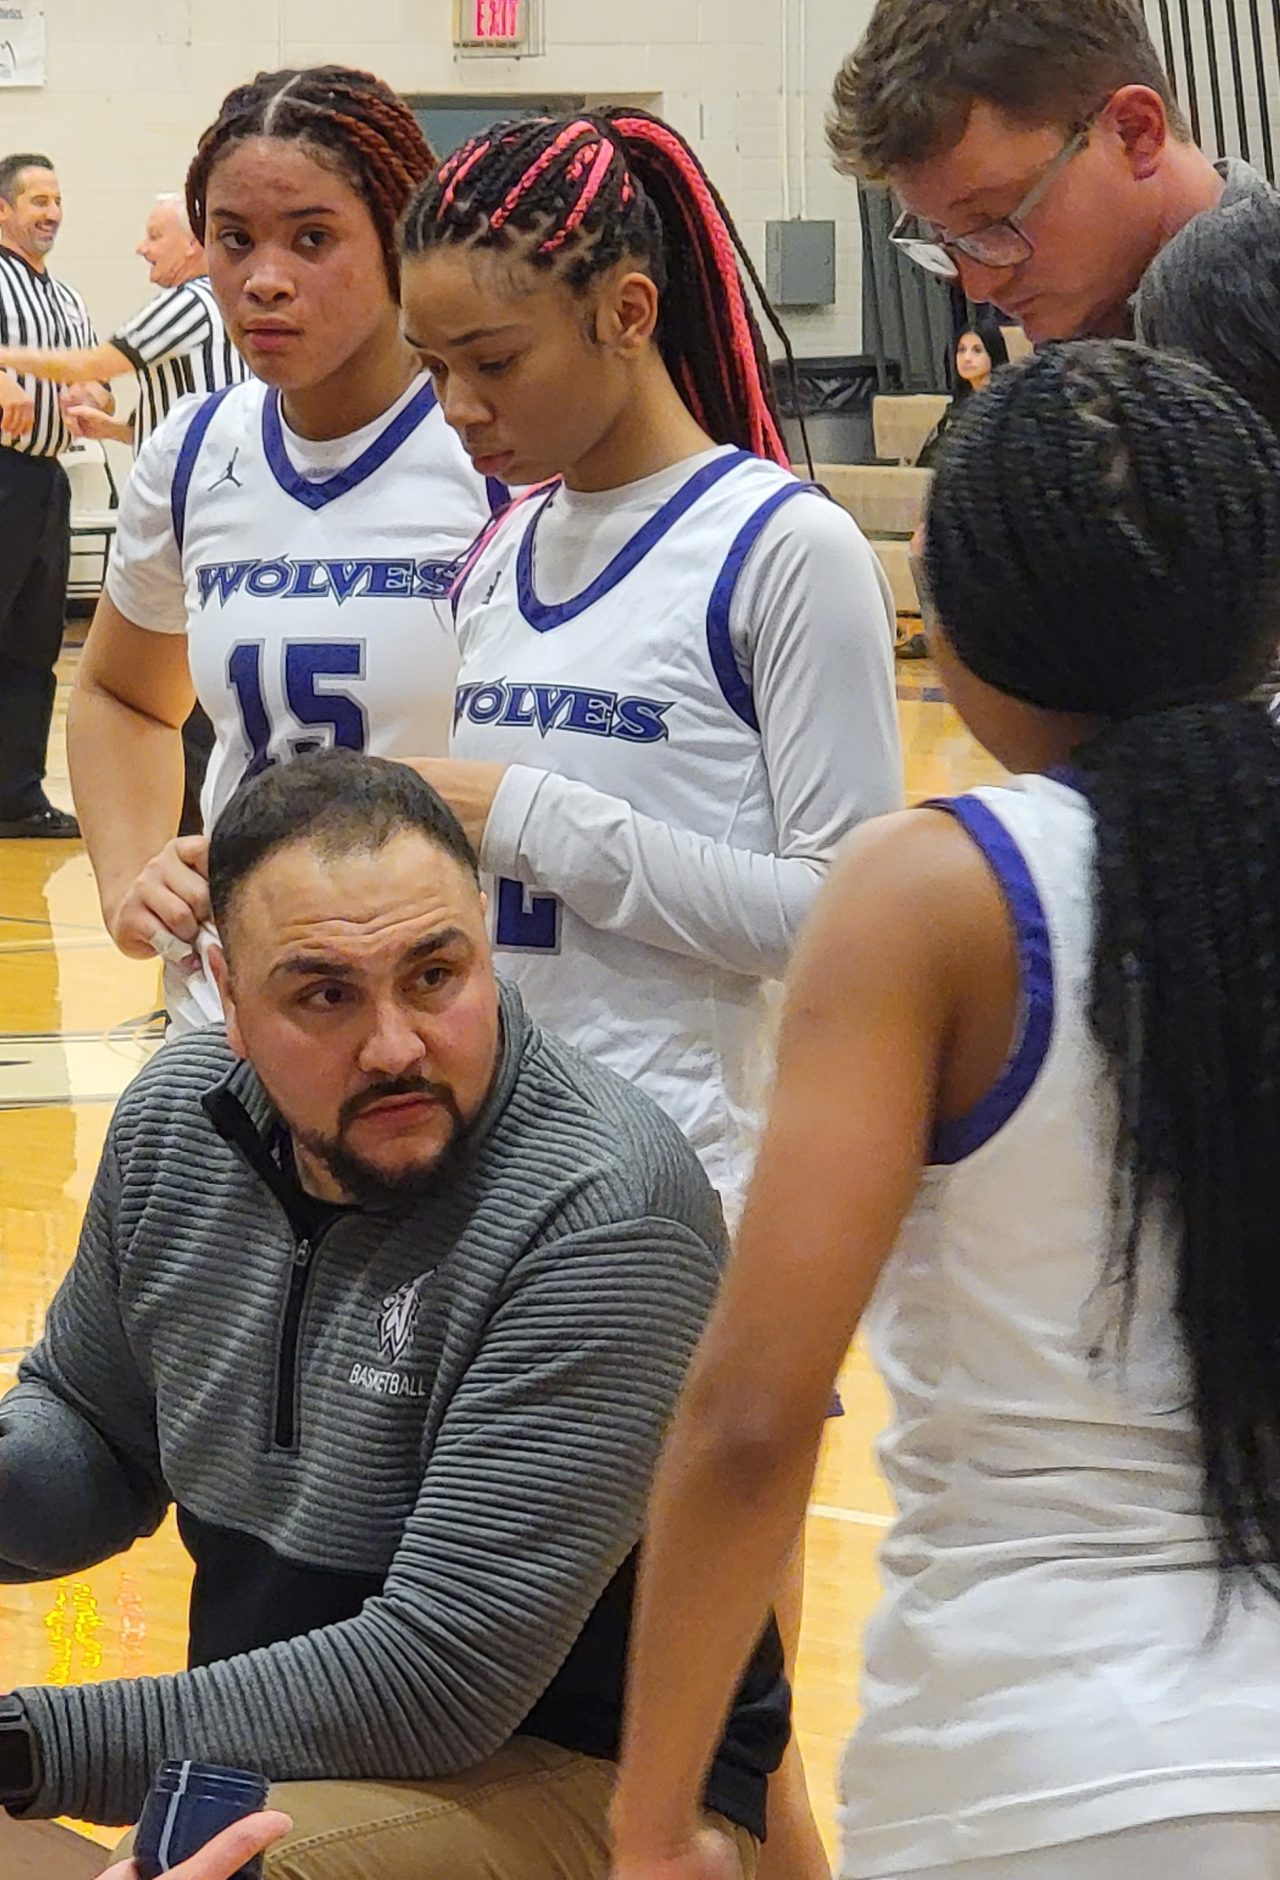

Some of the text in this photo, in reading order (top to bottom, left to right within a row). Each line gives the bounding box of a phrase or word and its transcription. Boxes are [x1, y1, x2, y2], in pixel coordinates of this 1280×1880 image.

[476, 0, 517, 36] EXIT
[197, 554, 466, 609] WOLVES
[224, 636, 370, 786] 15
[349, 1363, 426, 1397] BASKETBALL
